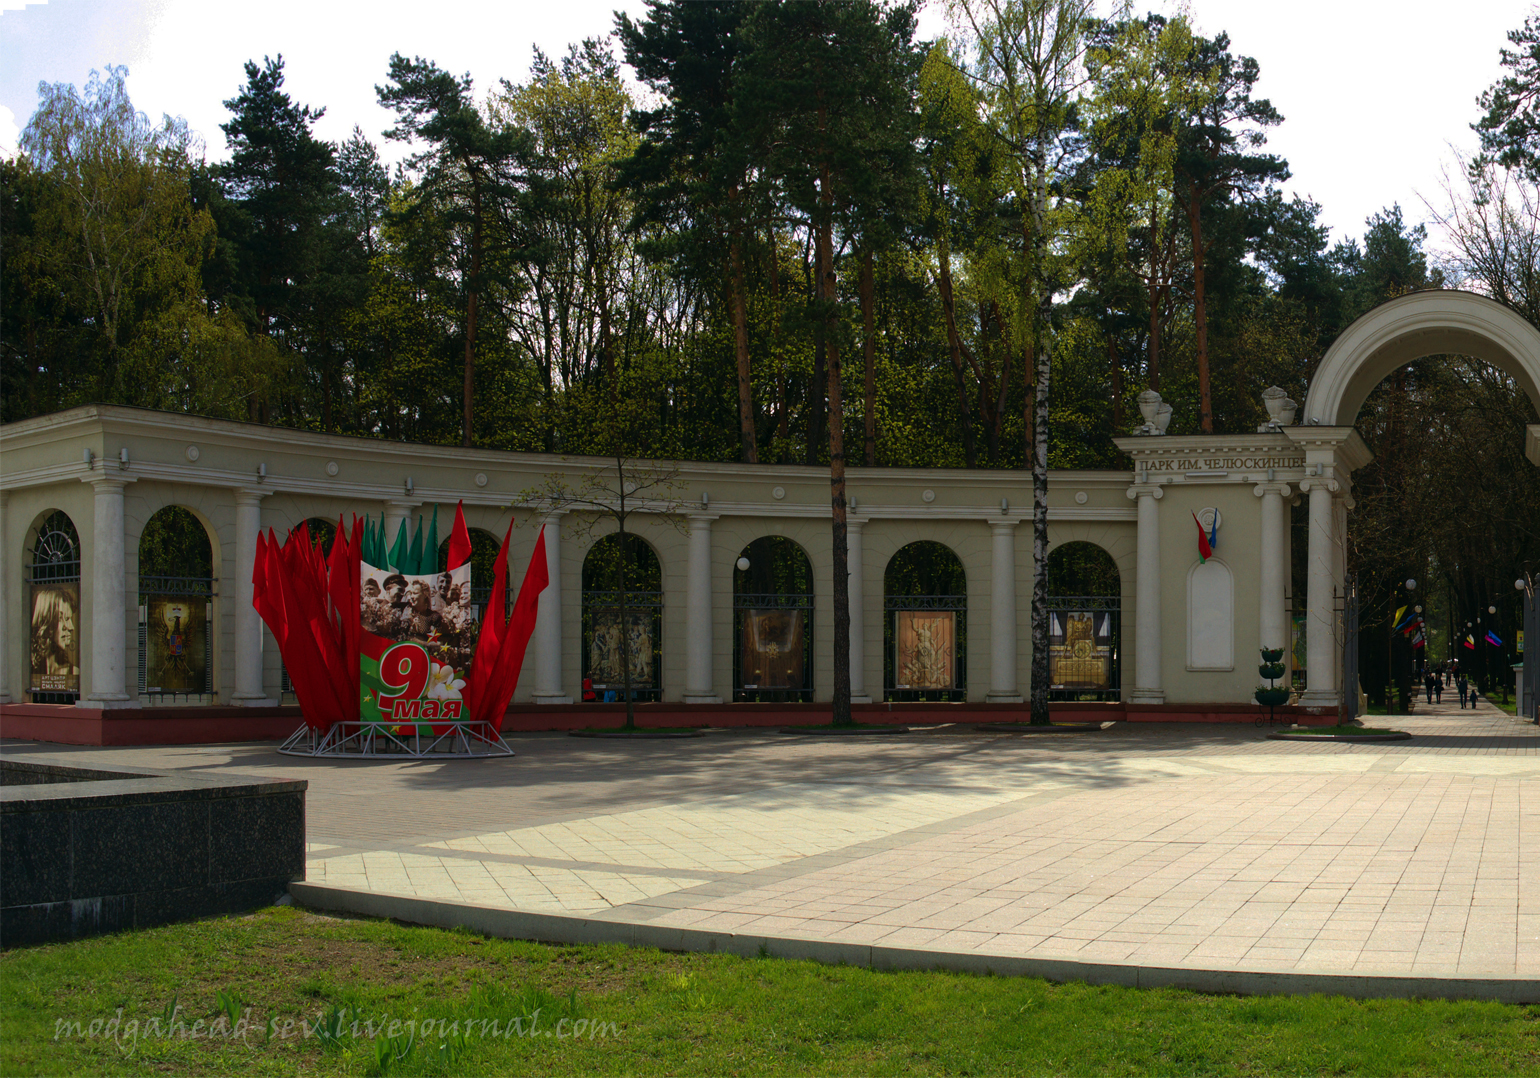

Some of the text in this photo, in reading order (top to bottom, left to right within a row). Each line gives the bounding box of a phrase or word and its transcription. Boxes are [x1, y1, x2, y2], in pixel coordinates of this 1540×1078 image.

[1139, 460, 1174, 471] ПАРК
[1177, 459, 1202, 470] ИМ.
[378, 642, 430, 711] 9
